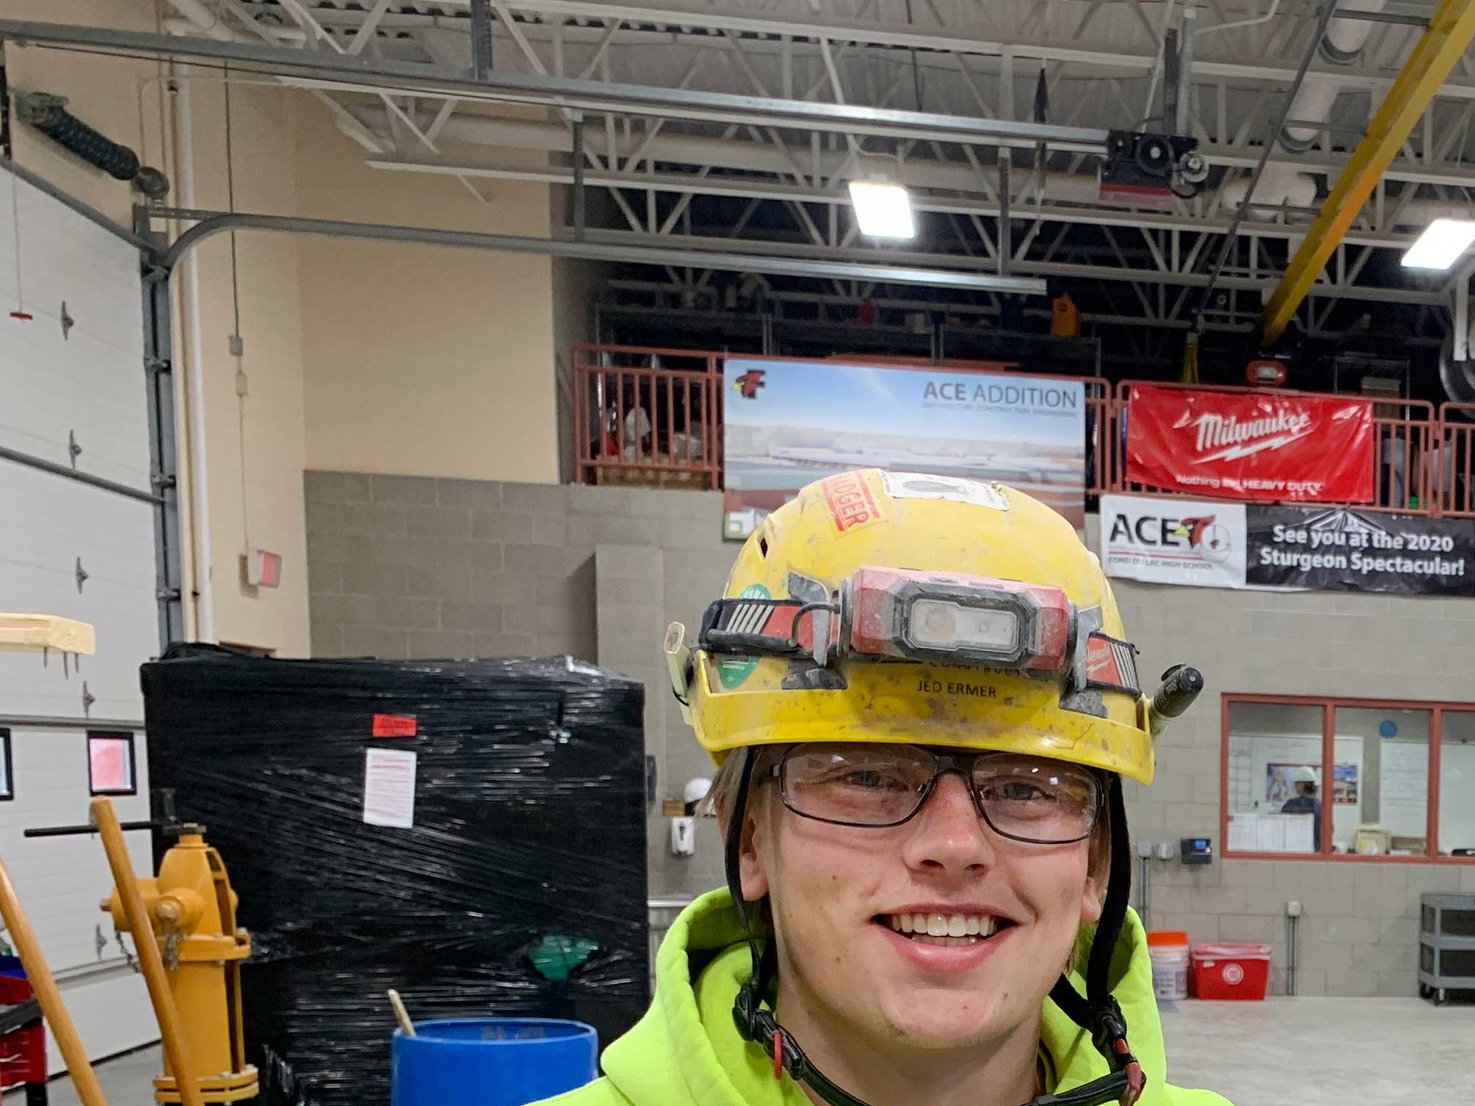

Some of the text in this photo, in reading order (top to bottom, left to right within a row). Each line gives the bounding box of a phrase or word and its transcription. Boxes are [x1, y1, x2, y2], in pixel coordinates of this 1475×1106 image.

[923, 381, 1077, 408] ACE ADDITION
[1193, 409, 1311, 452] Milwaukee
[1176, 474, 1220, 489] Nothing
[1243, 480, 1285, 491] HEAVY
[1109, 513, 1180, 547] ACE
[1273, 525, 1454, 552] See you at the 2020
[1182, 562, 1213, 570] SCHOOL
[1260, 547, 1465, 576] Sturgeon Spectacular!
[918, 680, 997, 698] JED ERMER
